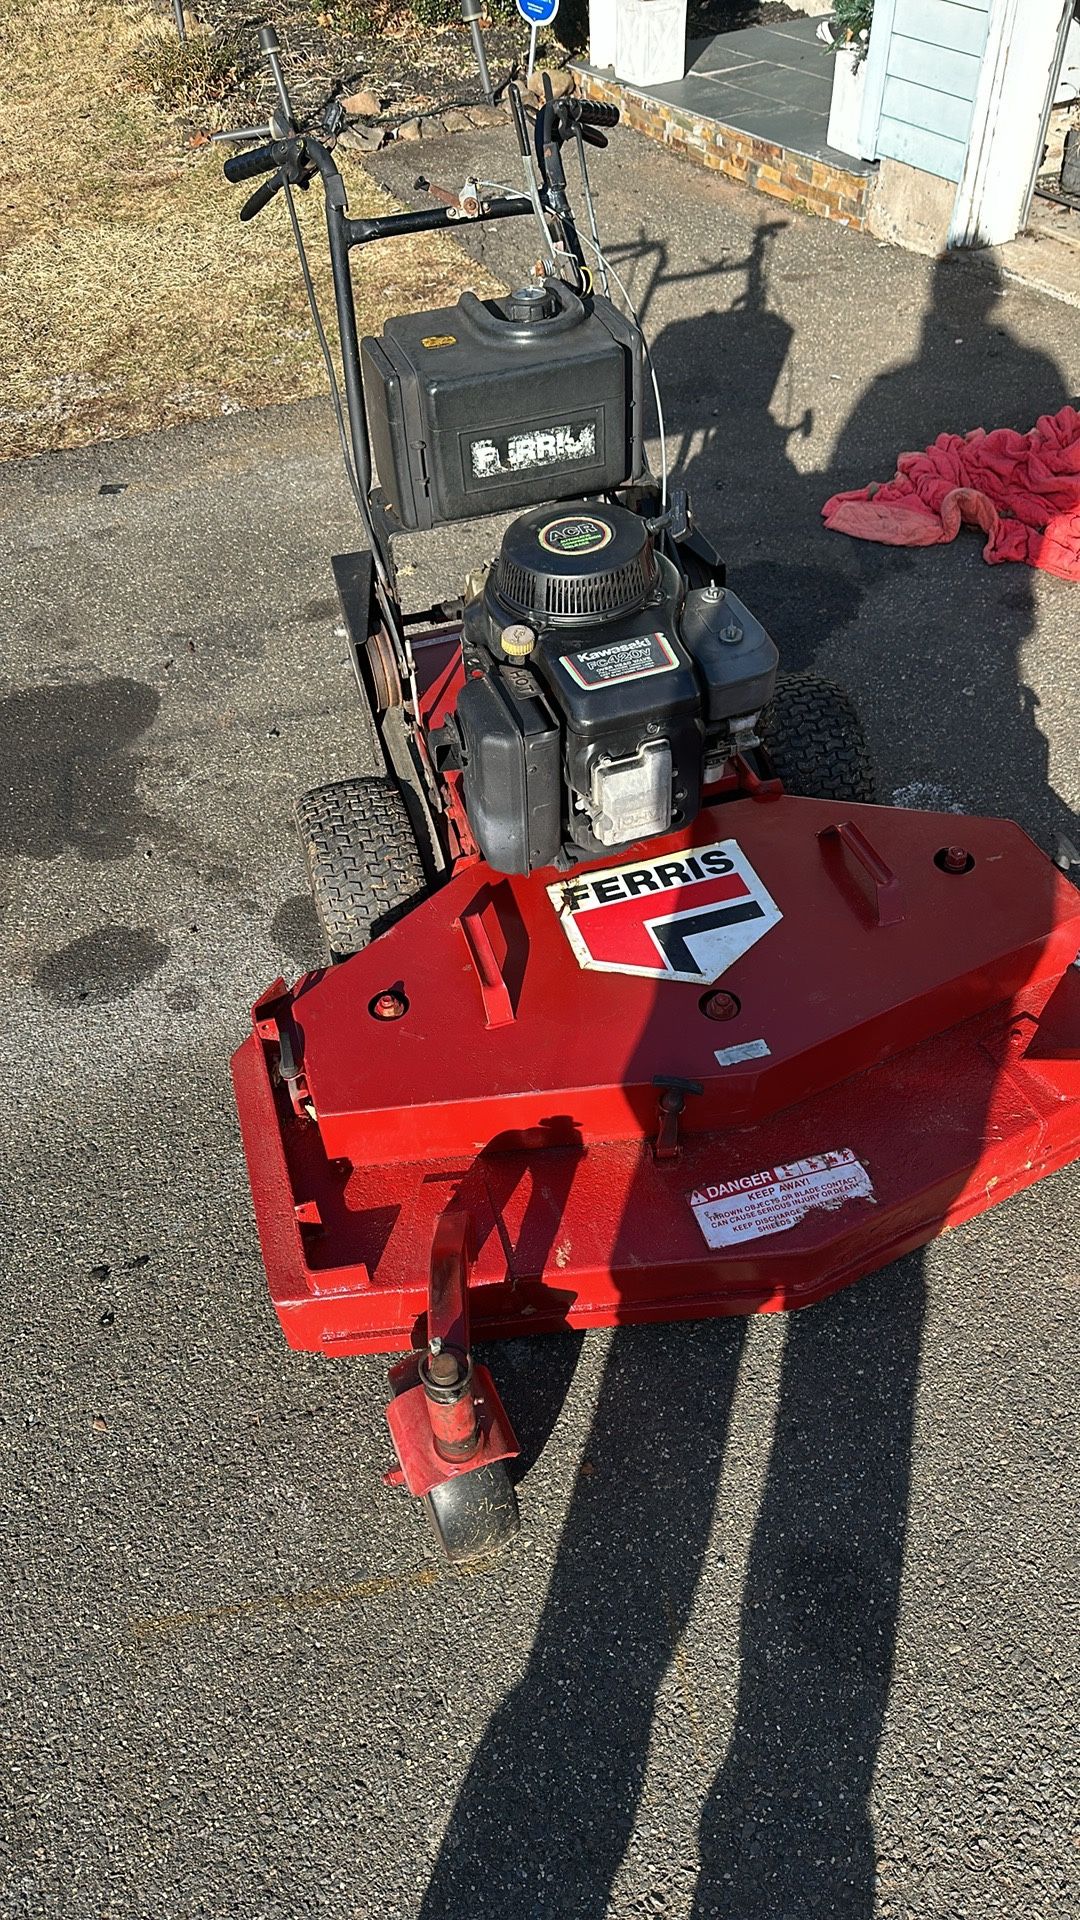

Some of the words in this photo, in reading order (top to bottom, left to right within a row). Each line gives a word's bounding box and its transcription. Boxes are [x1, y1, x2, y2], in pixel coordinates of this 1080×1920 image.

[549, 522, 598, 542] ACR
[576, 637, 652, 662] Kawasaki
[586, 647, 651, 671] FC420V
[509, 669, 535, 692] HOT
[563, 850, 735, 911] FERRIS
[706, 1171, 773, 1199] DANGER
[747, 1187, 775, 1201] KEEP
[779, 1177, 811, 1192] AWAY!
[708, 1207, 743, 1222] THROWN
[744, 1197, 781, 1212] OBJECTS
[781, 1194, 794, 1202] OR
[794, 1186, 820, 1198] BLADE
[820, 1176, 858, 1191] CONTACT
[711, 1219, 729, 1229] CAN
[729, 1211, 758, 1224] CAUSE
[757, 1201, 791, 1216] SERIOUS
[791, 1193, 820, 1206] INJURY
[821, 1189, 833, 1198] OR
[833, 1182, 860, 1195] DEATH
[732, 1221, 753, 1233] KEEP
[754, 1208, 803, 1226] DISCHARGE
[757, 1218, 792, 1233] SHIELDS
